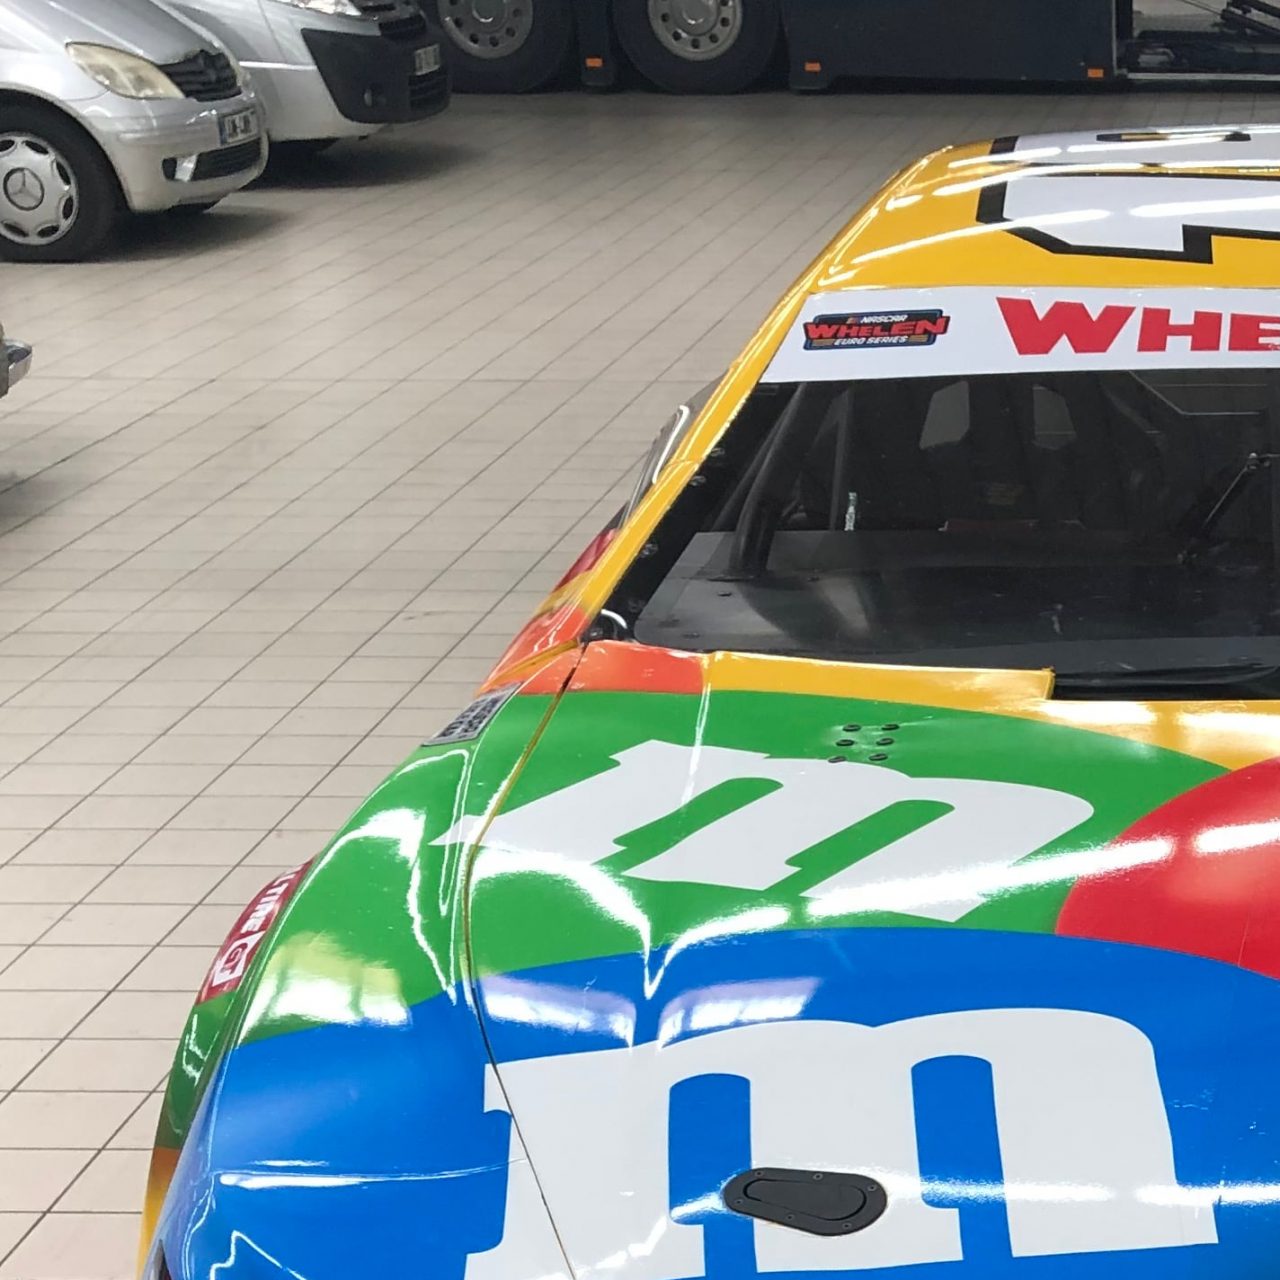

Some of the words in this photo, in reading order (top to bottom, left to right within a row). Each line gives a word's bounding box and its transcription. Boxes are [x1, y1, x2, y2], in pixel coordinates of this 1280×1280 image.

[860, 314, 908, 323] NASCAR
[805, 316, 950, 339] WHELEN
[834, 336, 864, 345] EURO
[866, 335, 908, 345] SERIES
